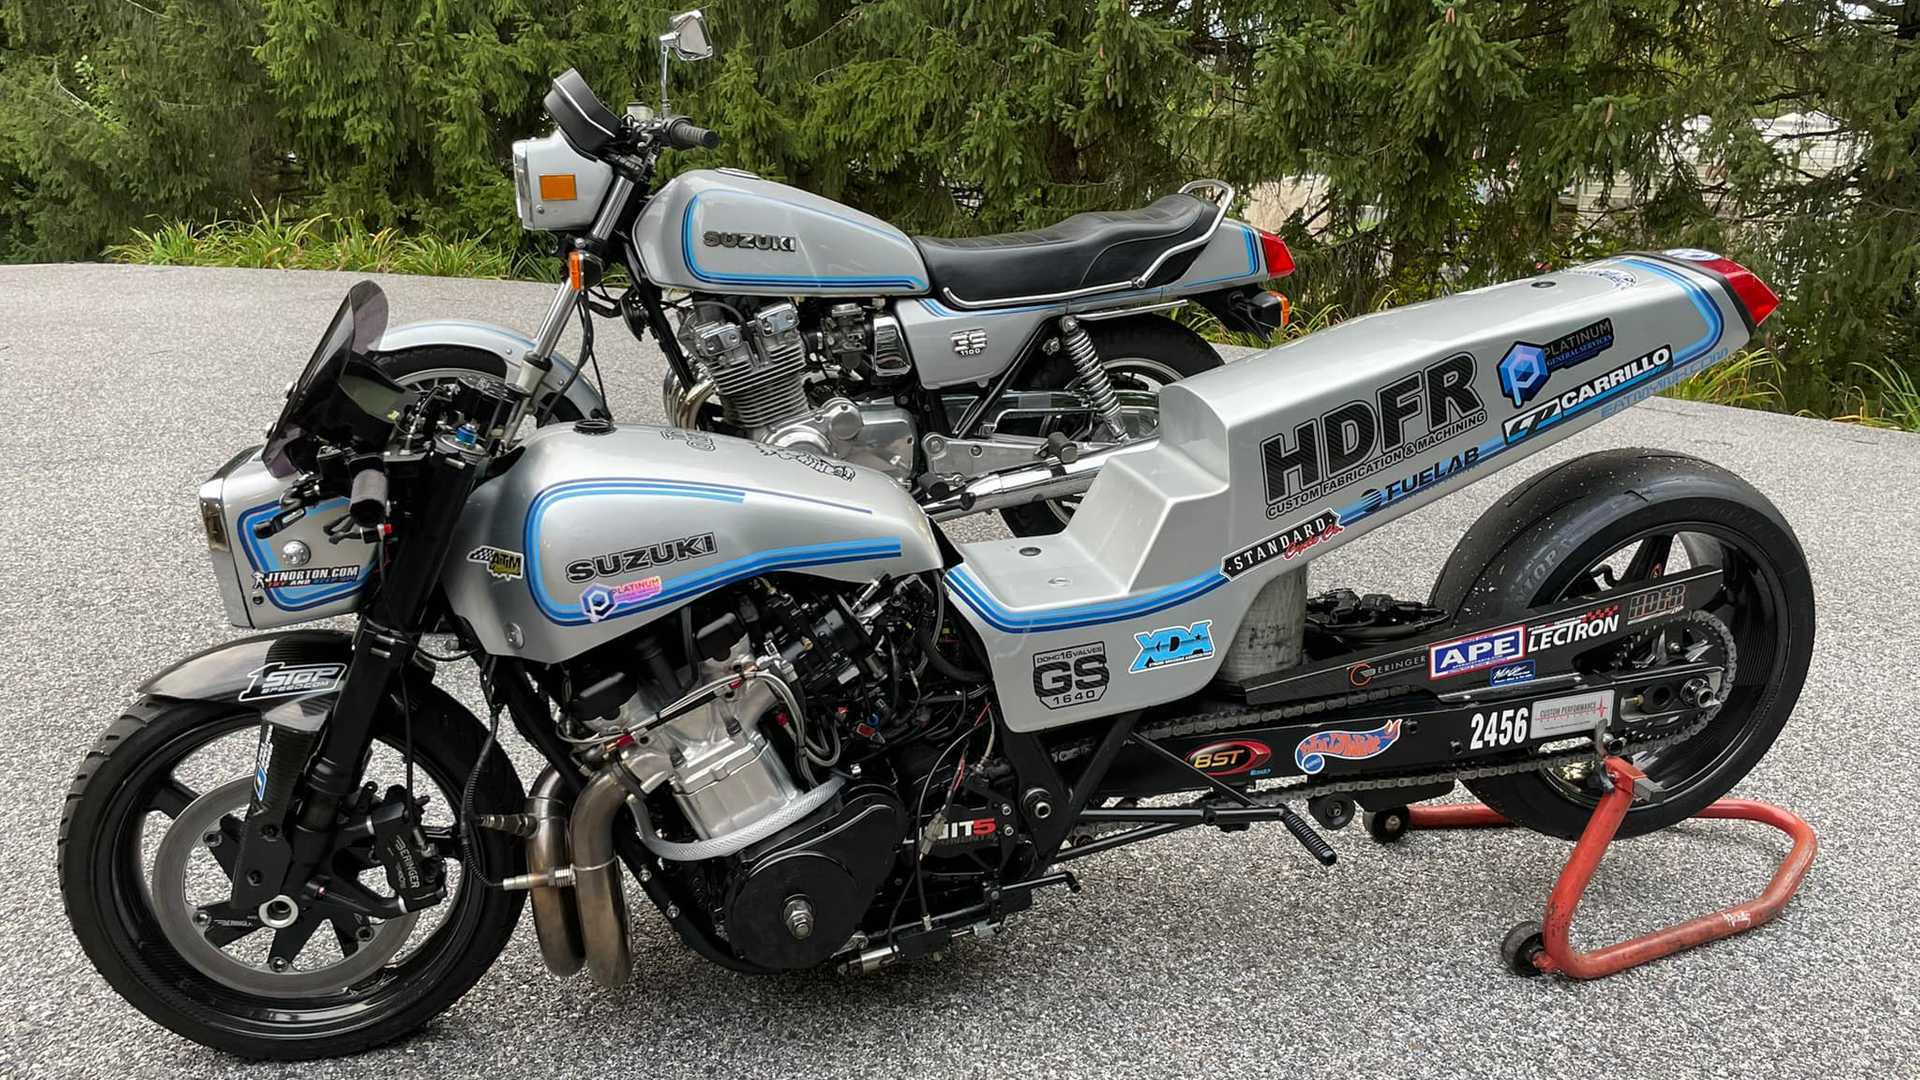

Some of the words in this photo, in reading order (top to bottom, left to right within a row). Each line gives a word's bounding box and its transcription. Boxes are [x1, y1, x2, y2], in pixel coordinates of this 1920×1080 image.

[703, 230, 797, 253] SUZUKI
[1543, 320, 1611, 357] PLATINUM
[1562, 347, 1670, 409] CARRILLO
[1260, 352, 1485, 505] HDFR
[1268, 486, 1320, 518] CUSTOM
[1322, 449, 1402, 492] FABRICATION
[1417, 413, 1486, 449] MACHINING
[1386, 447, 1480, 500] FUELAB
[567, 533, 717, 583] SUZUKI
[1233, 518, 1326, 570] STANDARD
[265, 566, 359, 582] JTNORTON.COM
[1440, 636, 1515, 669] APE
[1527, 615, 1619, 653] LECTRON
[1033, 654, 1110, 698] GS
[1053, 690, 1096, 705] 1640
[1470, 707, 1529, 750] 2456
[1194, 749, 1246, 769] BST
